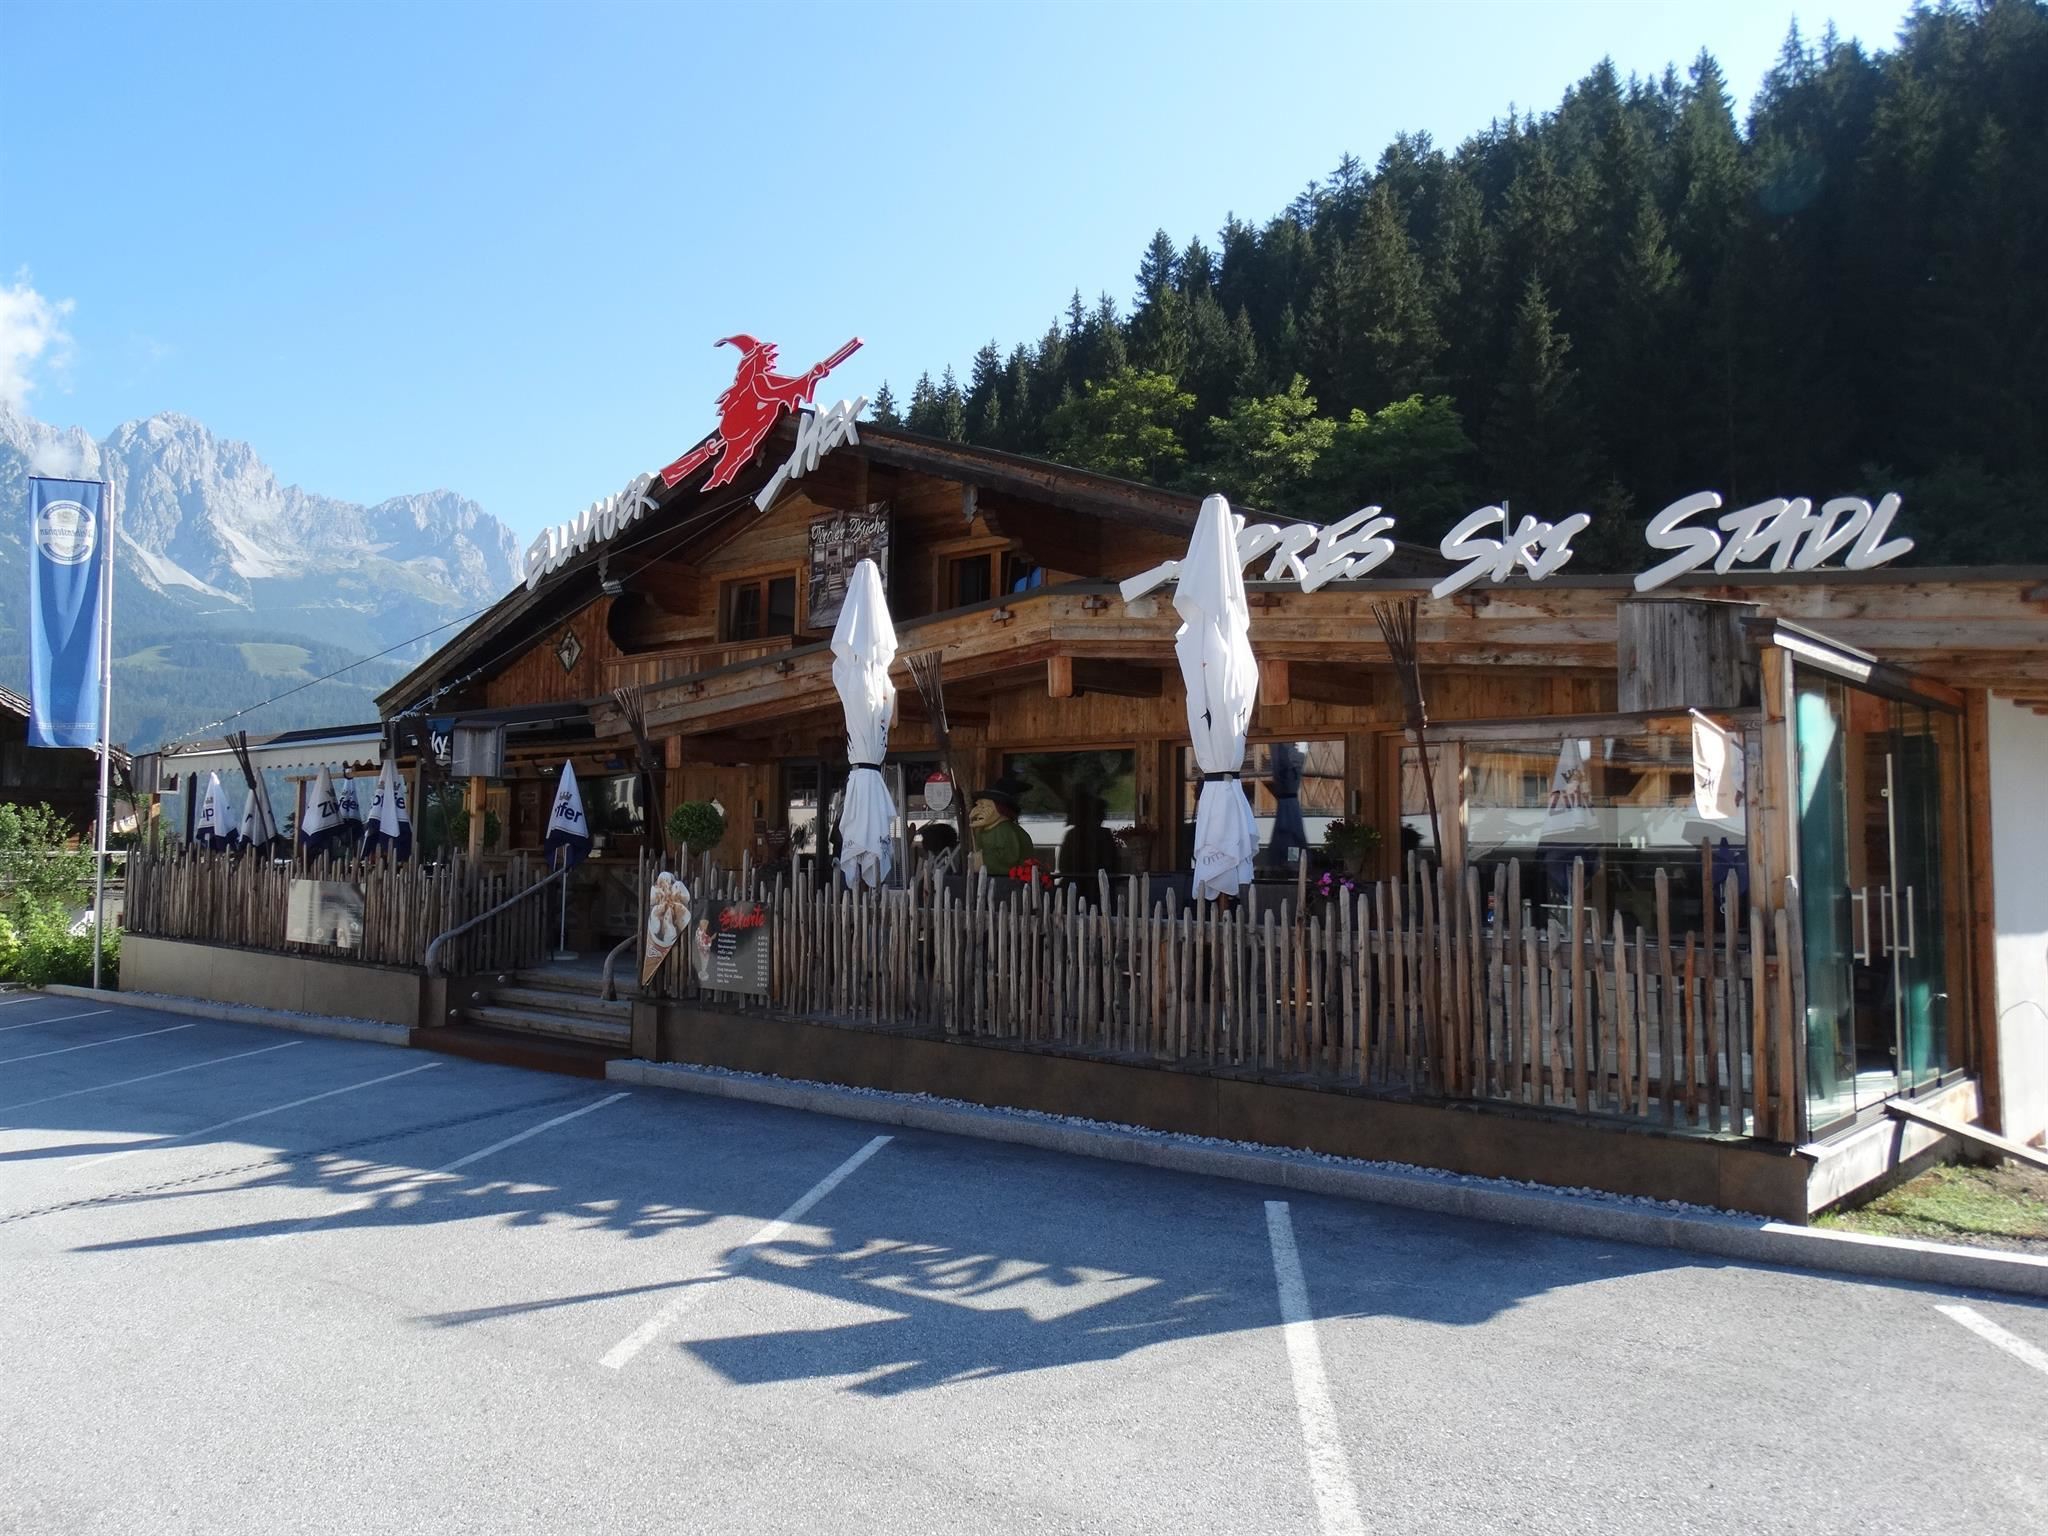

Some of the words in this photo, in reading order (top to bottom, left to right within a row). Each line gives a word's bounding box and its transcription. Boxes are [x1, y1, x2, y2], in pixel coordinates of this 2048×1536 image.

[754, 395, 869, 512] HEX
[811, 520, 846, 544] Tiroler
[849, 514, 887, 544] Küche
[1119, 506, 1395, 602] PRES
[1633, 490, 1916, 592] STADL
